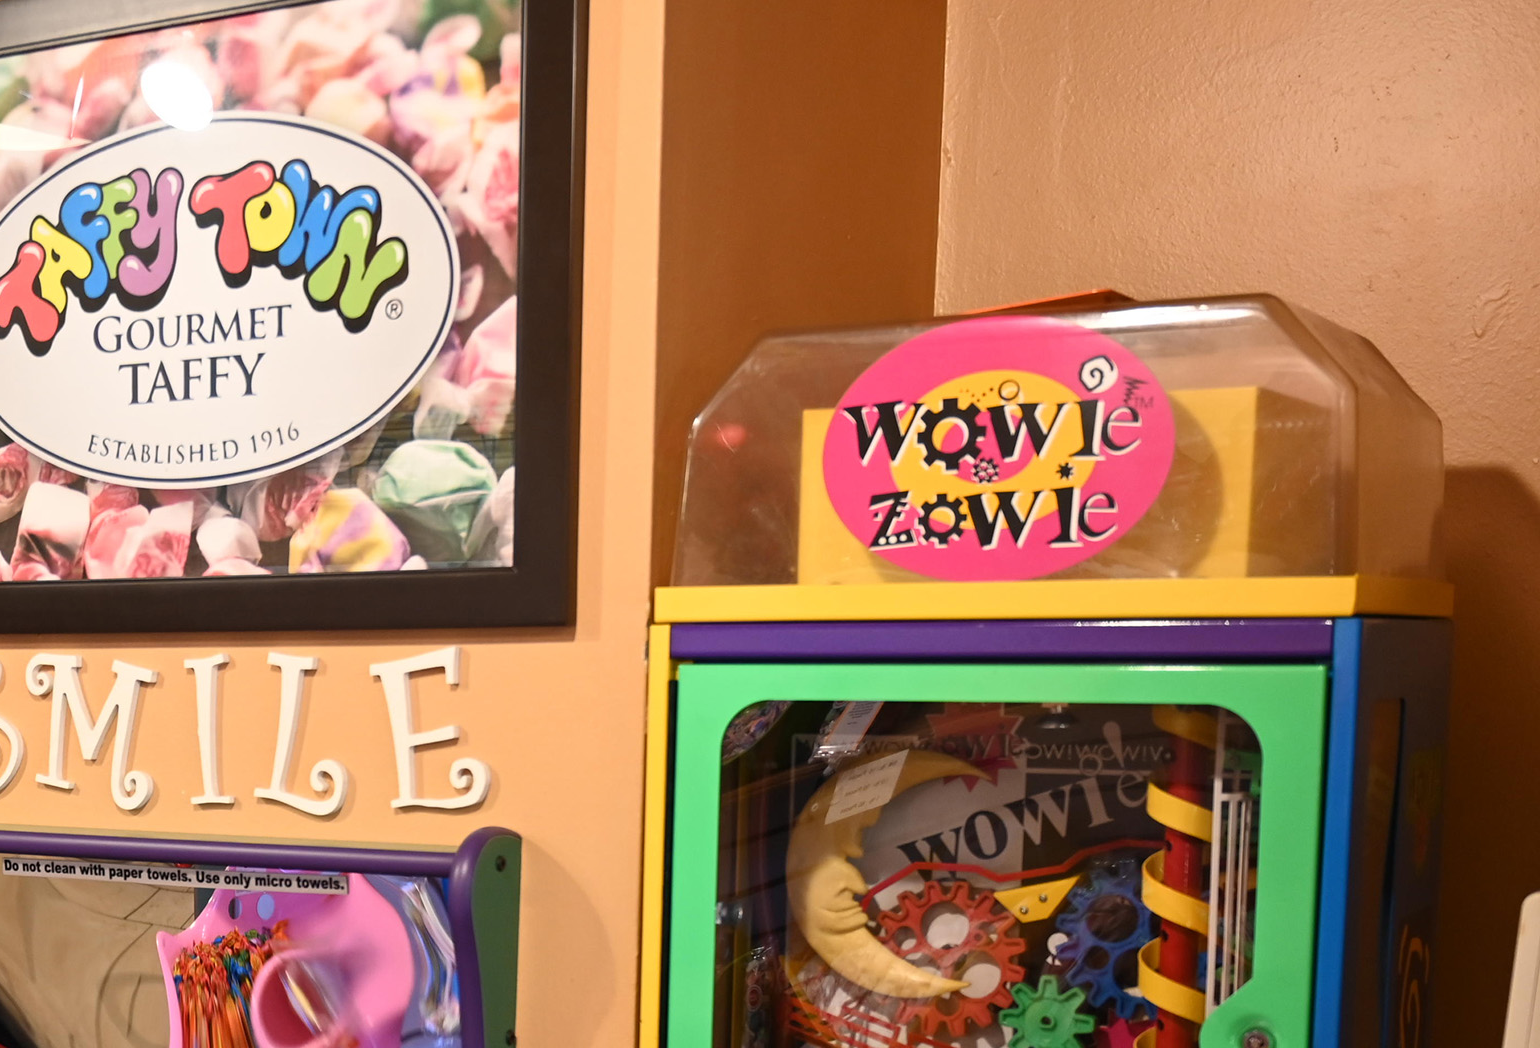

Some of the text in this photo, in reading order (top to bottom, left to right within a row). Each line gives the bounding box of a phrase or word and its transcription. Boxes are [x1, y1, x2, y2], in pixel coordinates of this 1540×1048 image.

[188, 159, 409, 334] TOWN
[92, 303, 292, 354] GOURMET
[119, 352, 265, 406] TAFFY
[87, 422, 301, 465] ESTABLISHED 1916
[3, 859, 345, 891] Do not clean with paper towels. Use only micro towels.
